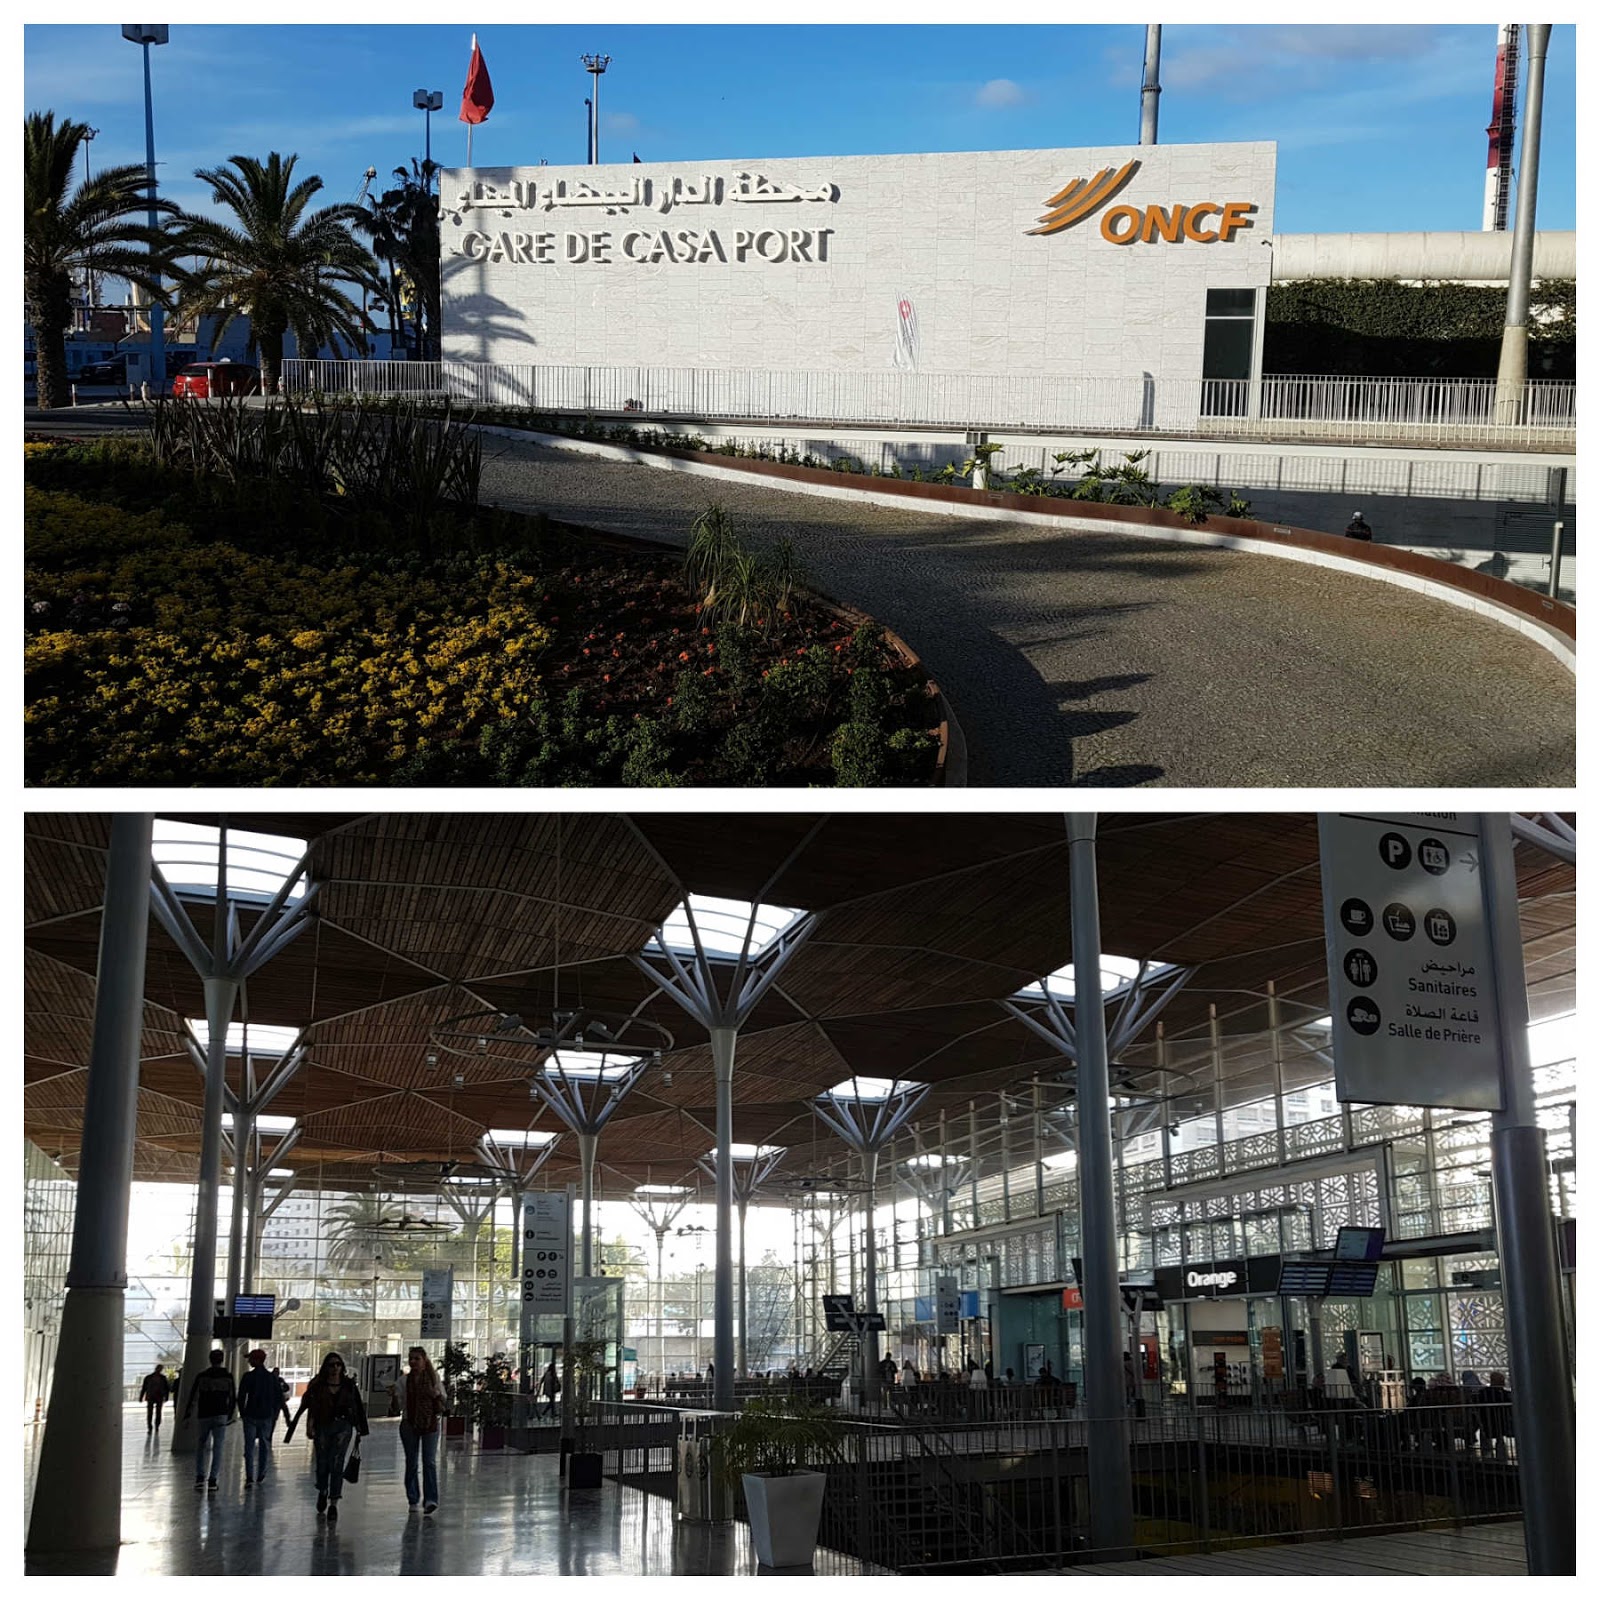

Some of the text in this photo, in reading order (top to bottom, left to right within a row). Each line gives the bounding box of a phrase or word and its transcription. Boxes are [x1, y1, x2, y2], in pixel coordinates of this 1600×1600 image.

[541, 177, 650, 215] البيضاء
[653, 175, 721, 214] الدار
[727, 171, 838, 203] محطة
[1100, 202, 1256, 245] ONCF
[462, 228, 832, 263] GARE DE CASA PORT
[1421, 959, 1476, 977] مراحيض
[1408, 977, 1477, 997] Sanitaires
[1406, 1003, 1479, 1023] قاعة الصلاة
[1388, 1022, 1481, 1044] Salle de Prière
[1187, 1271, 1237, 1289] Orange
